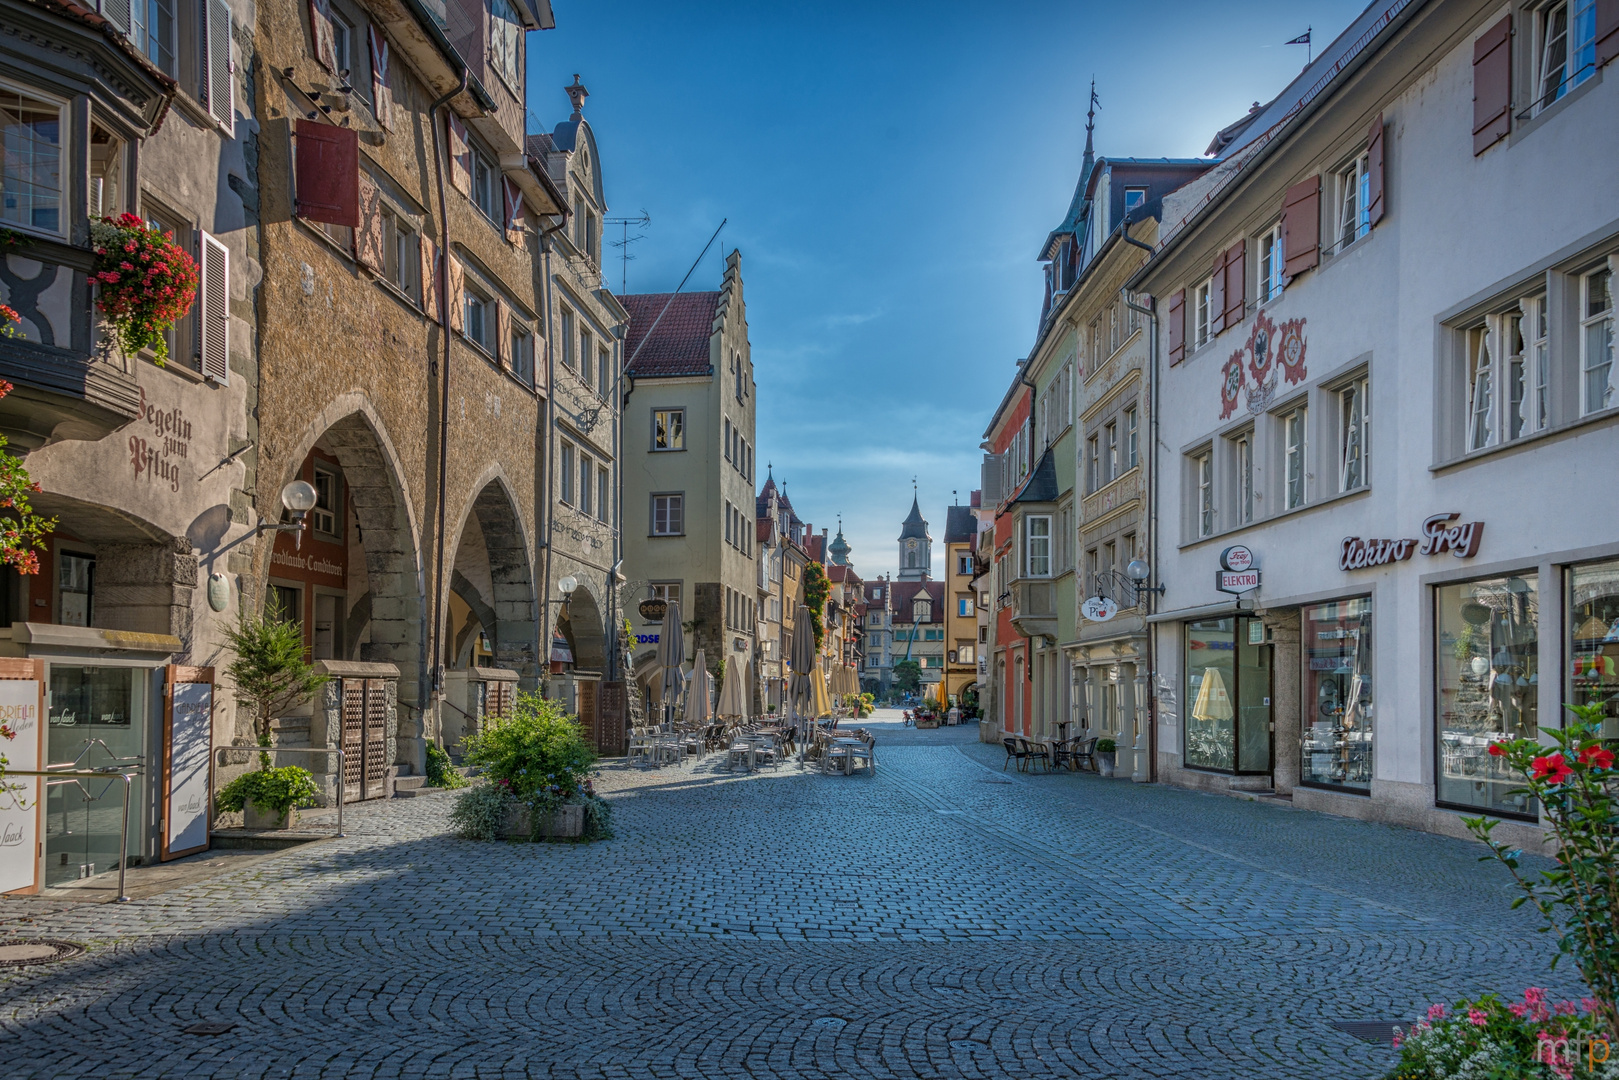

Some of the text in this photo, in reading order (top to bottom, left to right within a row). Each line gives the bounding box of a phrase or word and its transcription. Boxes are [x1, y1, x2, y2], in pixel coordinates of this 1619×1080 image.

[163, 436, 187, 458] zum
[129, 435, 179, 492] Pflug
[1339, 512, 1485, 571] Elektro Frey
[271, 549, 343, 577] rodlaube-Conditorei
[1229, 550, 1249, 561] Frey
[1223, 575, 1257, 587] ELEKTRO
[640, 605, 668, 613] HUGO
